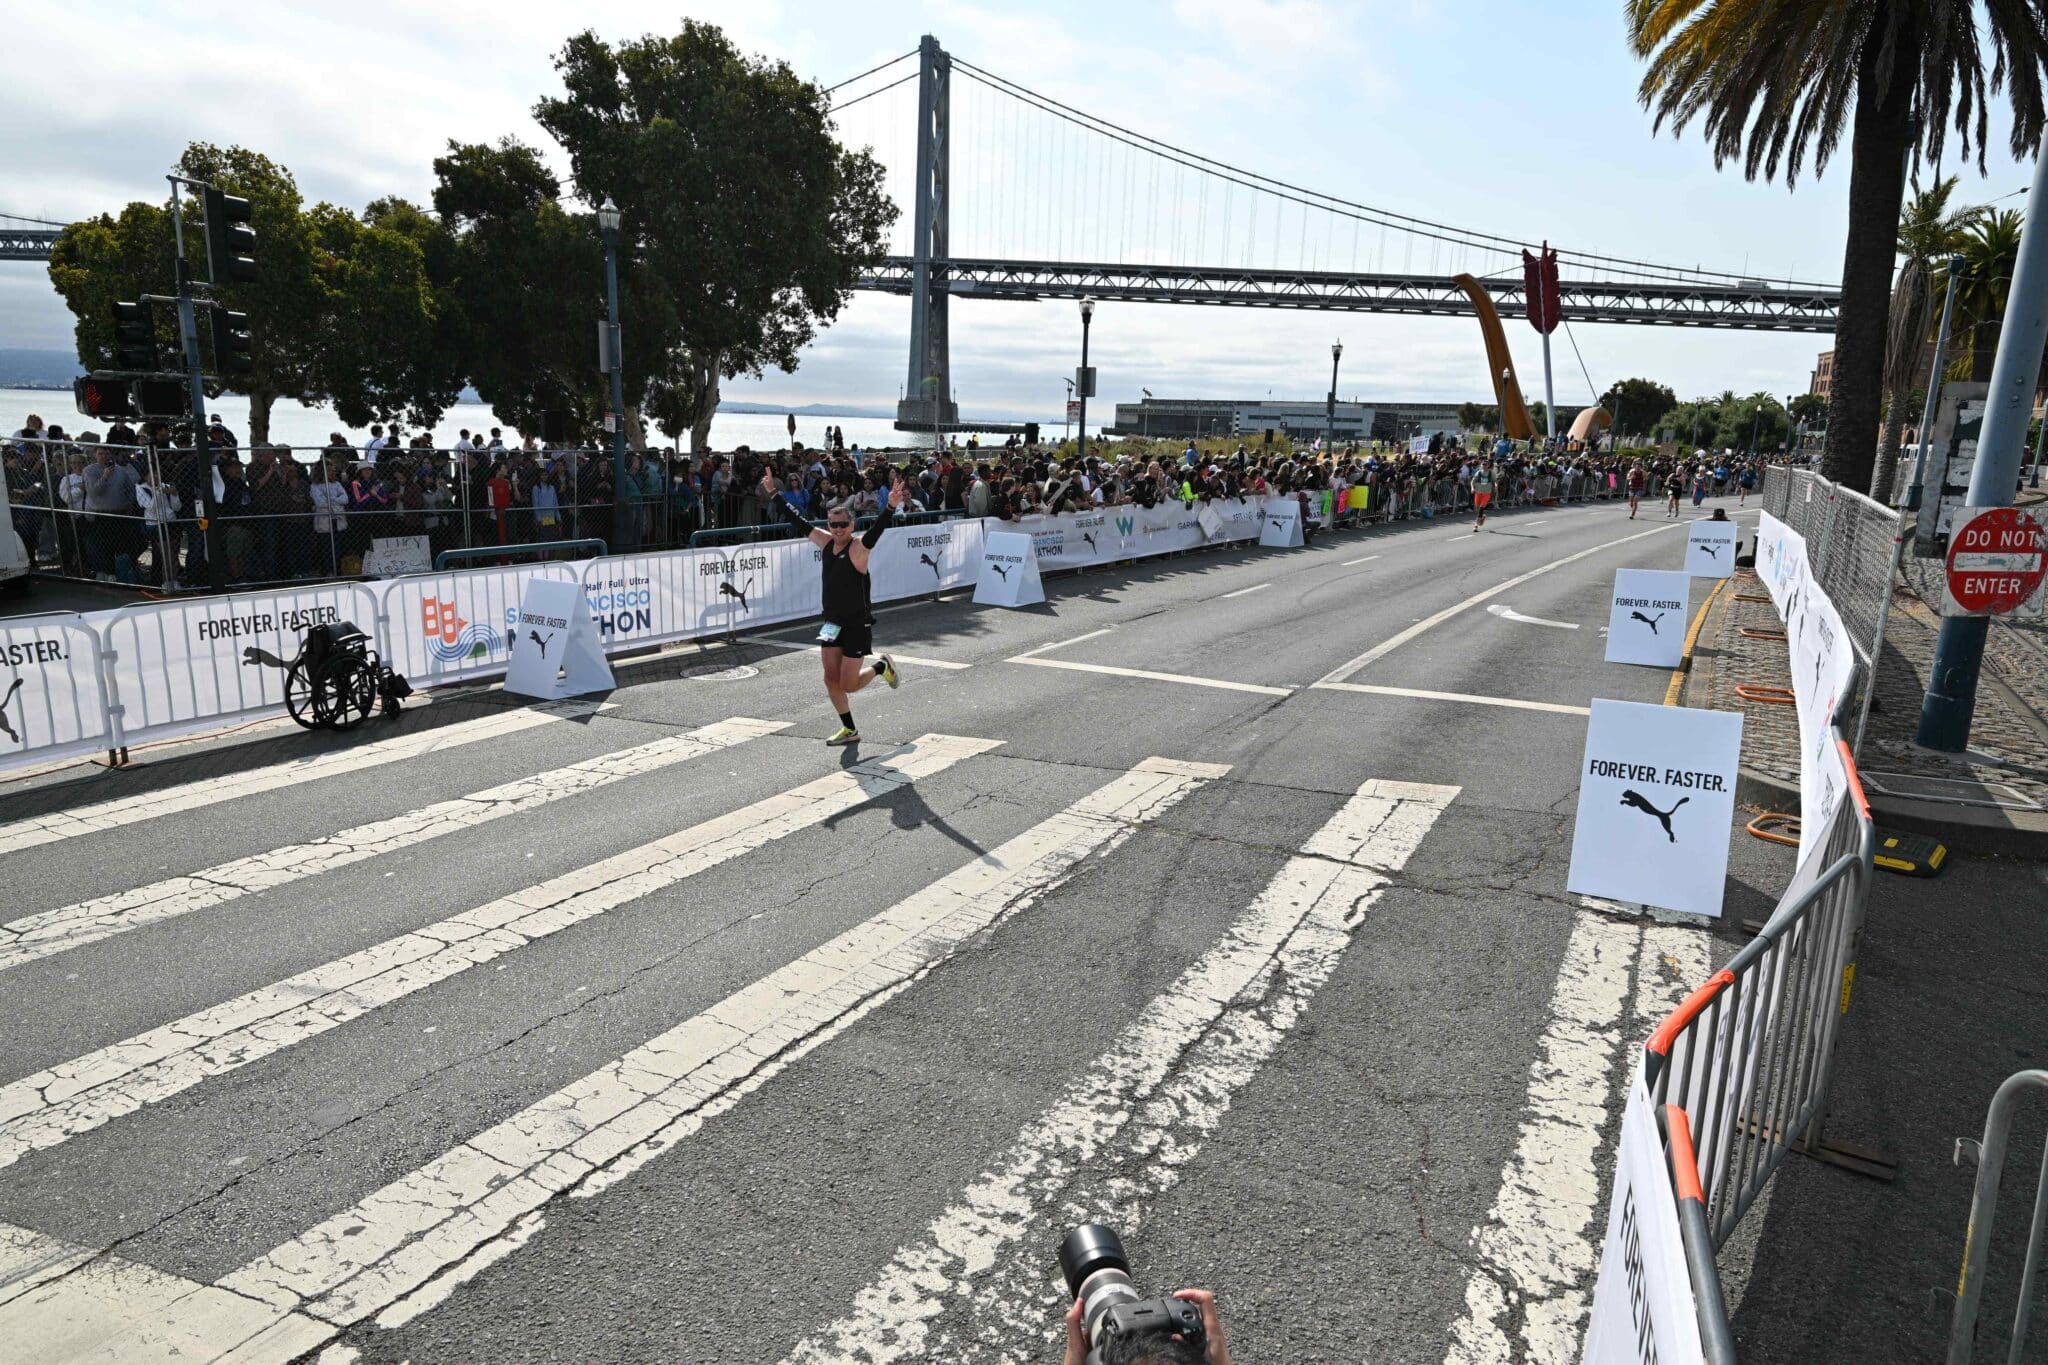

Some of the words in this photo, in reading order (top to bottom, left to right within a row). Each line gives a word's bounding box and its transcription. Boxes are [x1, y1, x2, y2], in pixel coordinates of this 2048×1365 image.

[1965, 530, 1991, 547] DO
[2000, 530, 2036, 547] NOT
[700, 560, 738, 576] FOREVER.
[740, 556, 768, 571] FASTER.
[585, 581, 603, 591] Half
[629, 576, 650, 586] Ultra
[1963, 578, 2021, 595] ENTER
[587, 589, 650, 612] NCISCO
[1615, 597, 1651, 608] FOREVER.
[1652, 600, 1683, 610] FASTER.
[198, 612, 279, 641] FOREVER.
[521, 613, 546, 626] FOREVER.
[546, 617, 568, 630] FASTER.
[0, 640, 69, 667] ASTER.
[1589, 759, 1661, 784] FOREVER.
[1664, 768, 1728, 793] FASTER.
[1620, 1180, 1659, 1365] FOREVE
